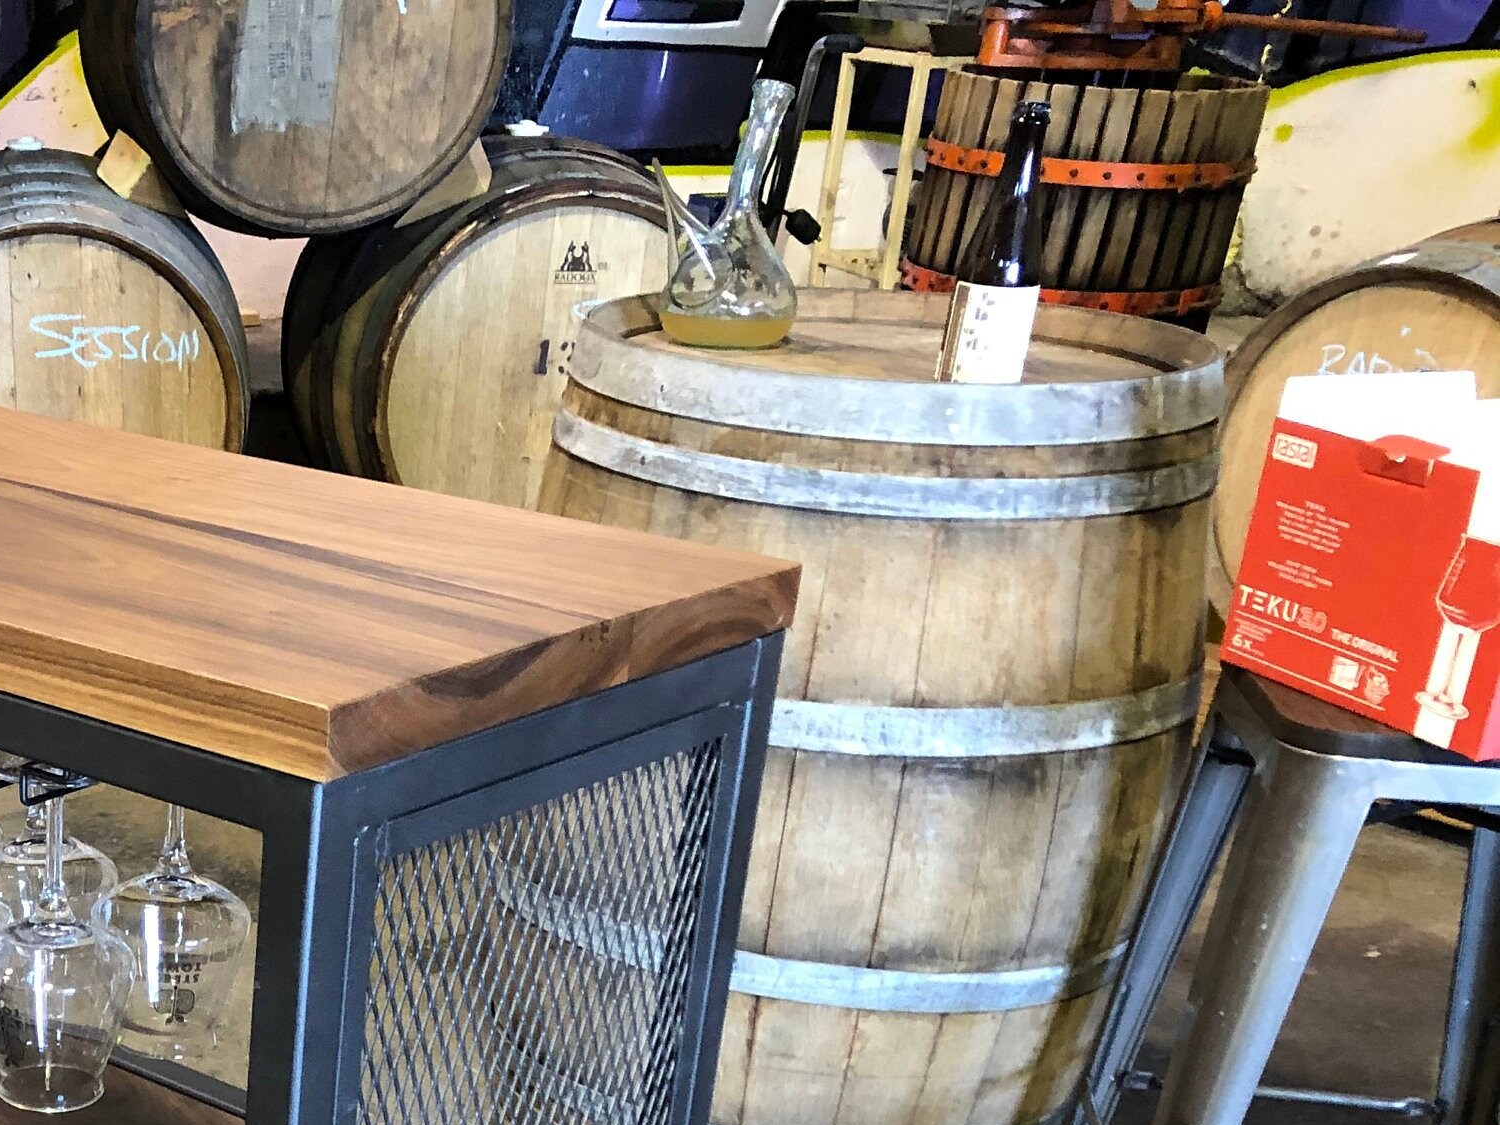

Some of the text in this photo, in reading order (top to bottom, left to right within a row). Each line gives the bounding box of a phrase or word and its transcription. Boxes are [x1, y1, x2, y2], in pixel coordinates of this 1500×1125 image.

[28, 312, 200, 371] SESSION
[1239, 584, 1300, 622] TEKU
[1331, 627, 1352, 645] THE
